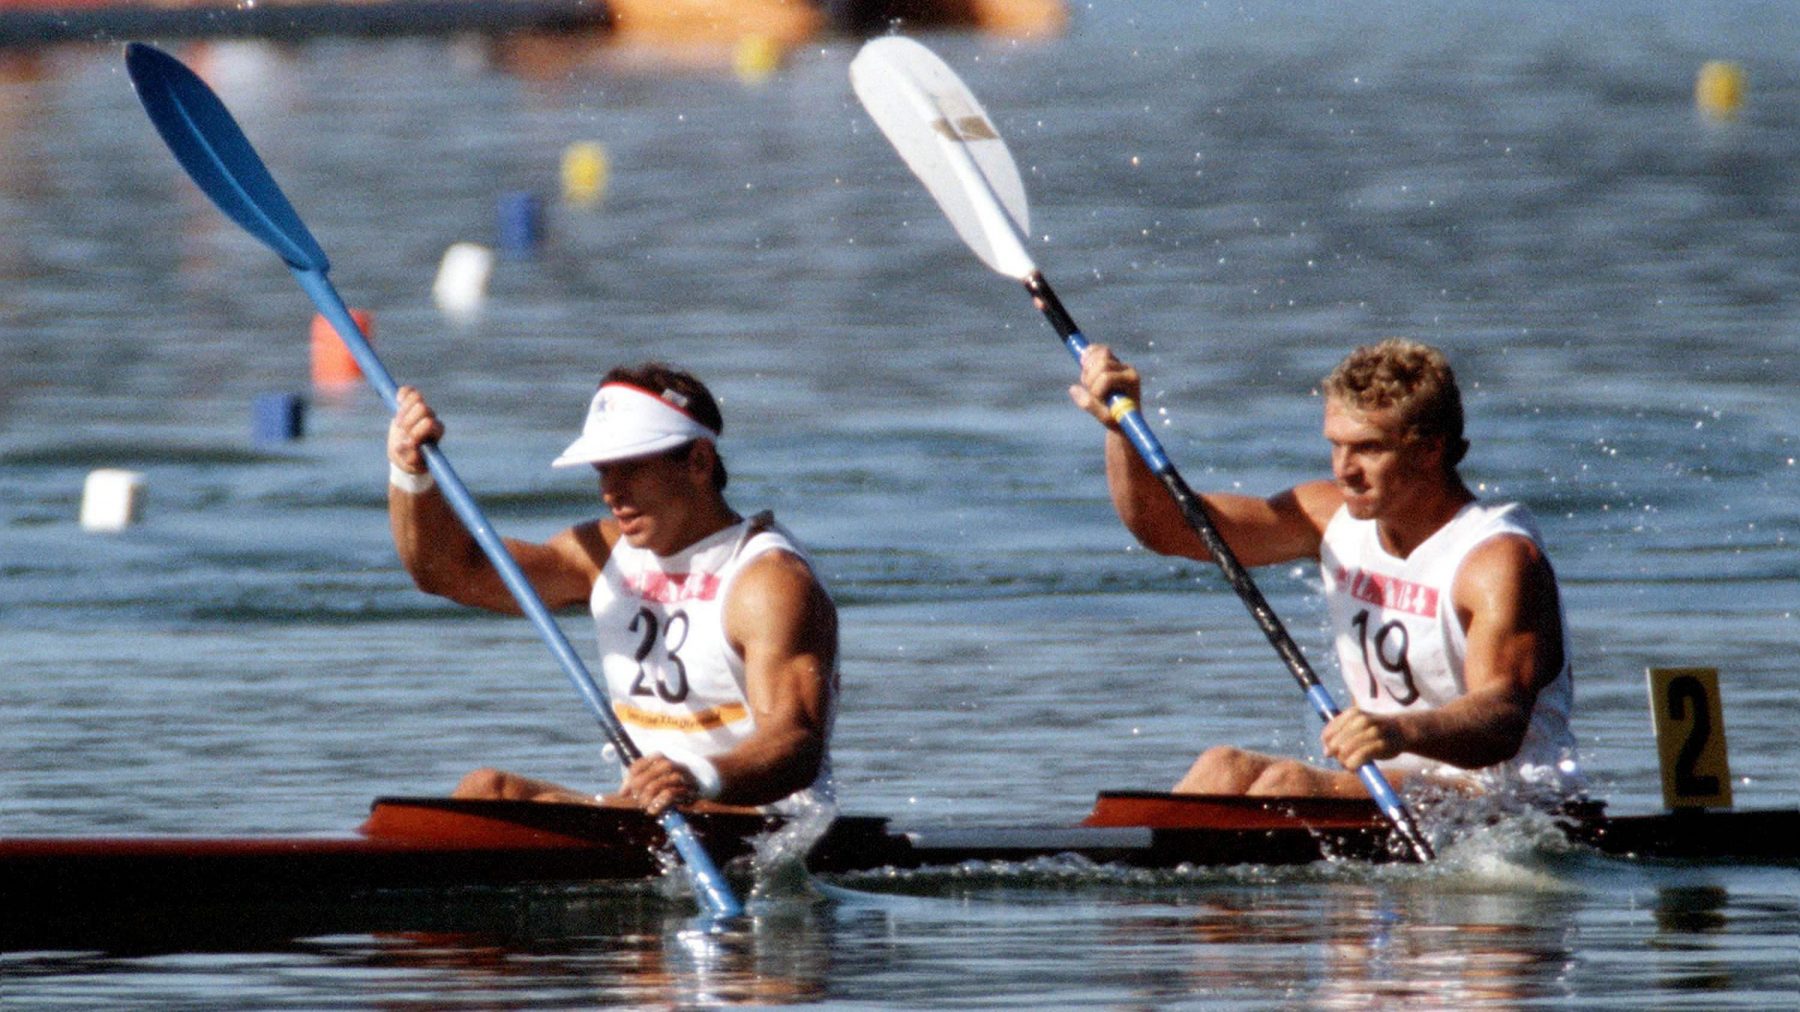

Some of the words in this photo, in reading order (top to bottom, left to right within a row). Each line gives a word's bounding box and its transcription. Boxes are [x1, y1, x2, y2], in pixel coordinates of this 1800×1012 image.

[628, 606, 690, 704] 23
[1352, 609, 1420, 706] 19
[1667, 675, 1721, 796] 2
